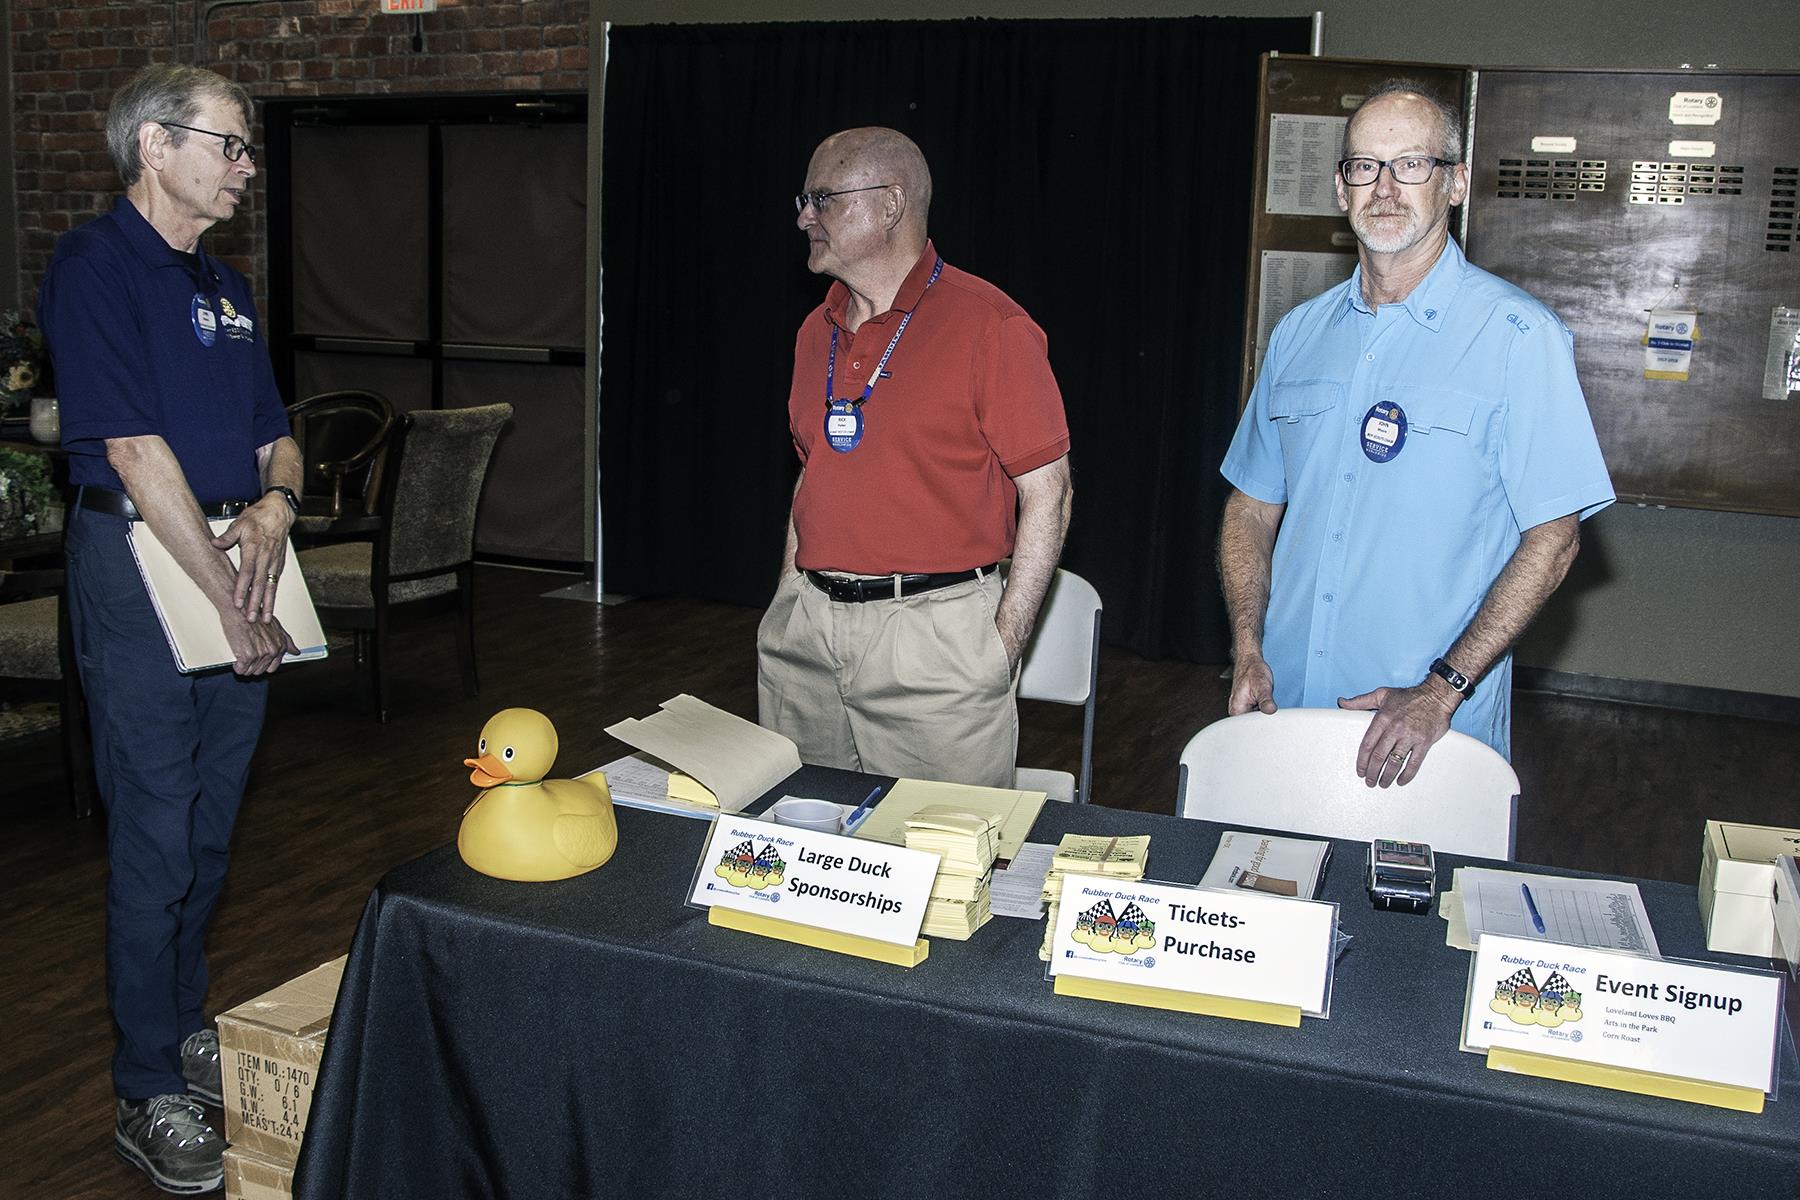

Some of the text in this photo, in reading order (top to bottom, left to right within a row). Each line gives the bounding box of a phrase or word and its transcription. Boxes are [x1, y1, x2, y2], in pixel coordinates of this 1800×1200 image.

[1366, 441, 1389, 453] SERVICE
[731, 829, 795, 847] Rubber Duck Race
[798, 847, 892, 879] Large Duck
[754, 890, 770, 899] Rotary
[788, 877, 902, 914] Sponsorships
[1082, 887, 1161, 904] Rubber Duck Race
[1168, 903, 1245, 928] Tickets-
[1164, 935, 1256, 963] Purchase
[1123, 955, 1143, 965] Rotary
[1500, 954, 1587, 974] Rubber Duck Race
[1596, 974, 1743, 1015] Event Signup
[1605, 1006, 1676, 1024] Loveland Loves BBQ
[1547, 1028, 1569, 1038] Rotary
[1604, 1019, 1618, 1027] Arts
[1628, 1022, 1640, 1030] the
[1641, 1024, 1658, 1033] Park
[1602, 1031, 1641, 1043] Corn Roast
[237, 1051, 260, 1071] ITEM
[237, 1066, 260, 1086] QTY:
[282, 1110, 299, 1127] 4.4
